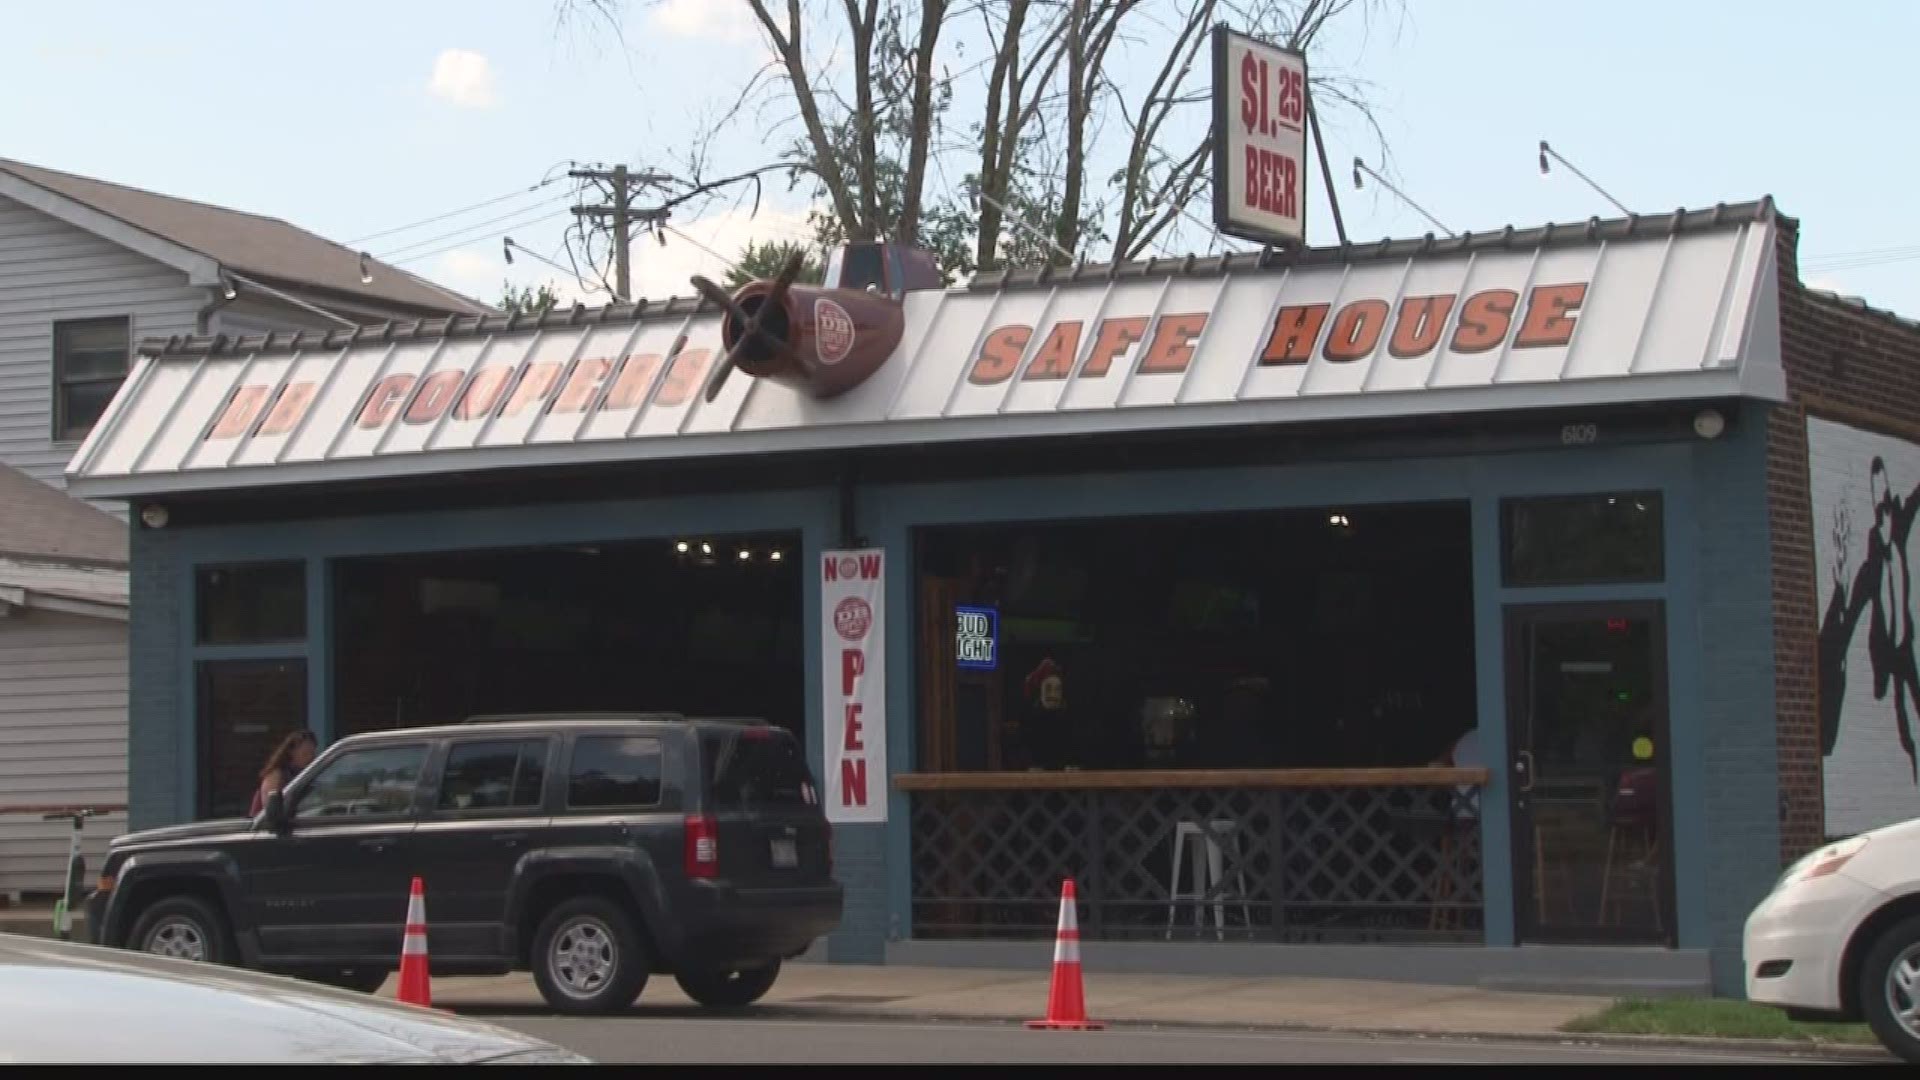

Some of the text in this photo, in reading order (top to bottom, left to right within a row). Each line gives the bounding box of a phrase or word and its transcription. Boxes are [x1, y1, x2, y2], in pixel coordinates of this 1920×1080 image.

[1245, 143, 1297, 219] BEER
[204, 380, 316, 441] DB
[967, 311, 1210, 386] SAFE
[1258, 282, 1589, 367] HOUSE
[1561, 423, 1597, 445] 6109
[824, 554, 881, 582] NOW
[956, 611, 989, 636] BUD
[956, 636, 995, 662] IGHT
